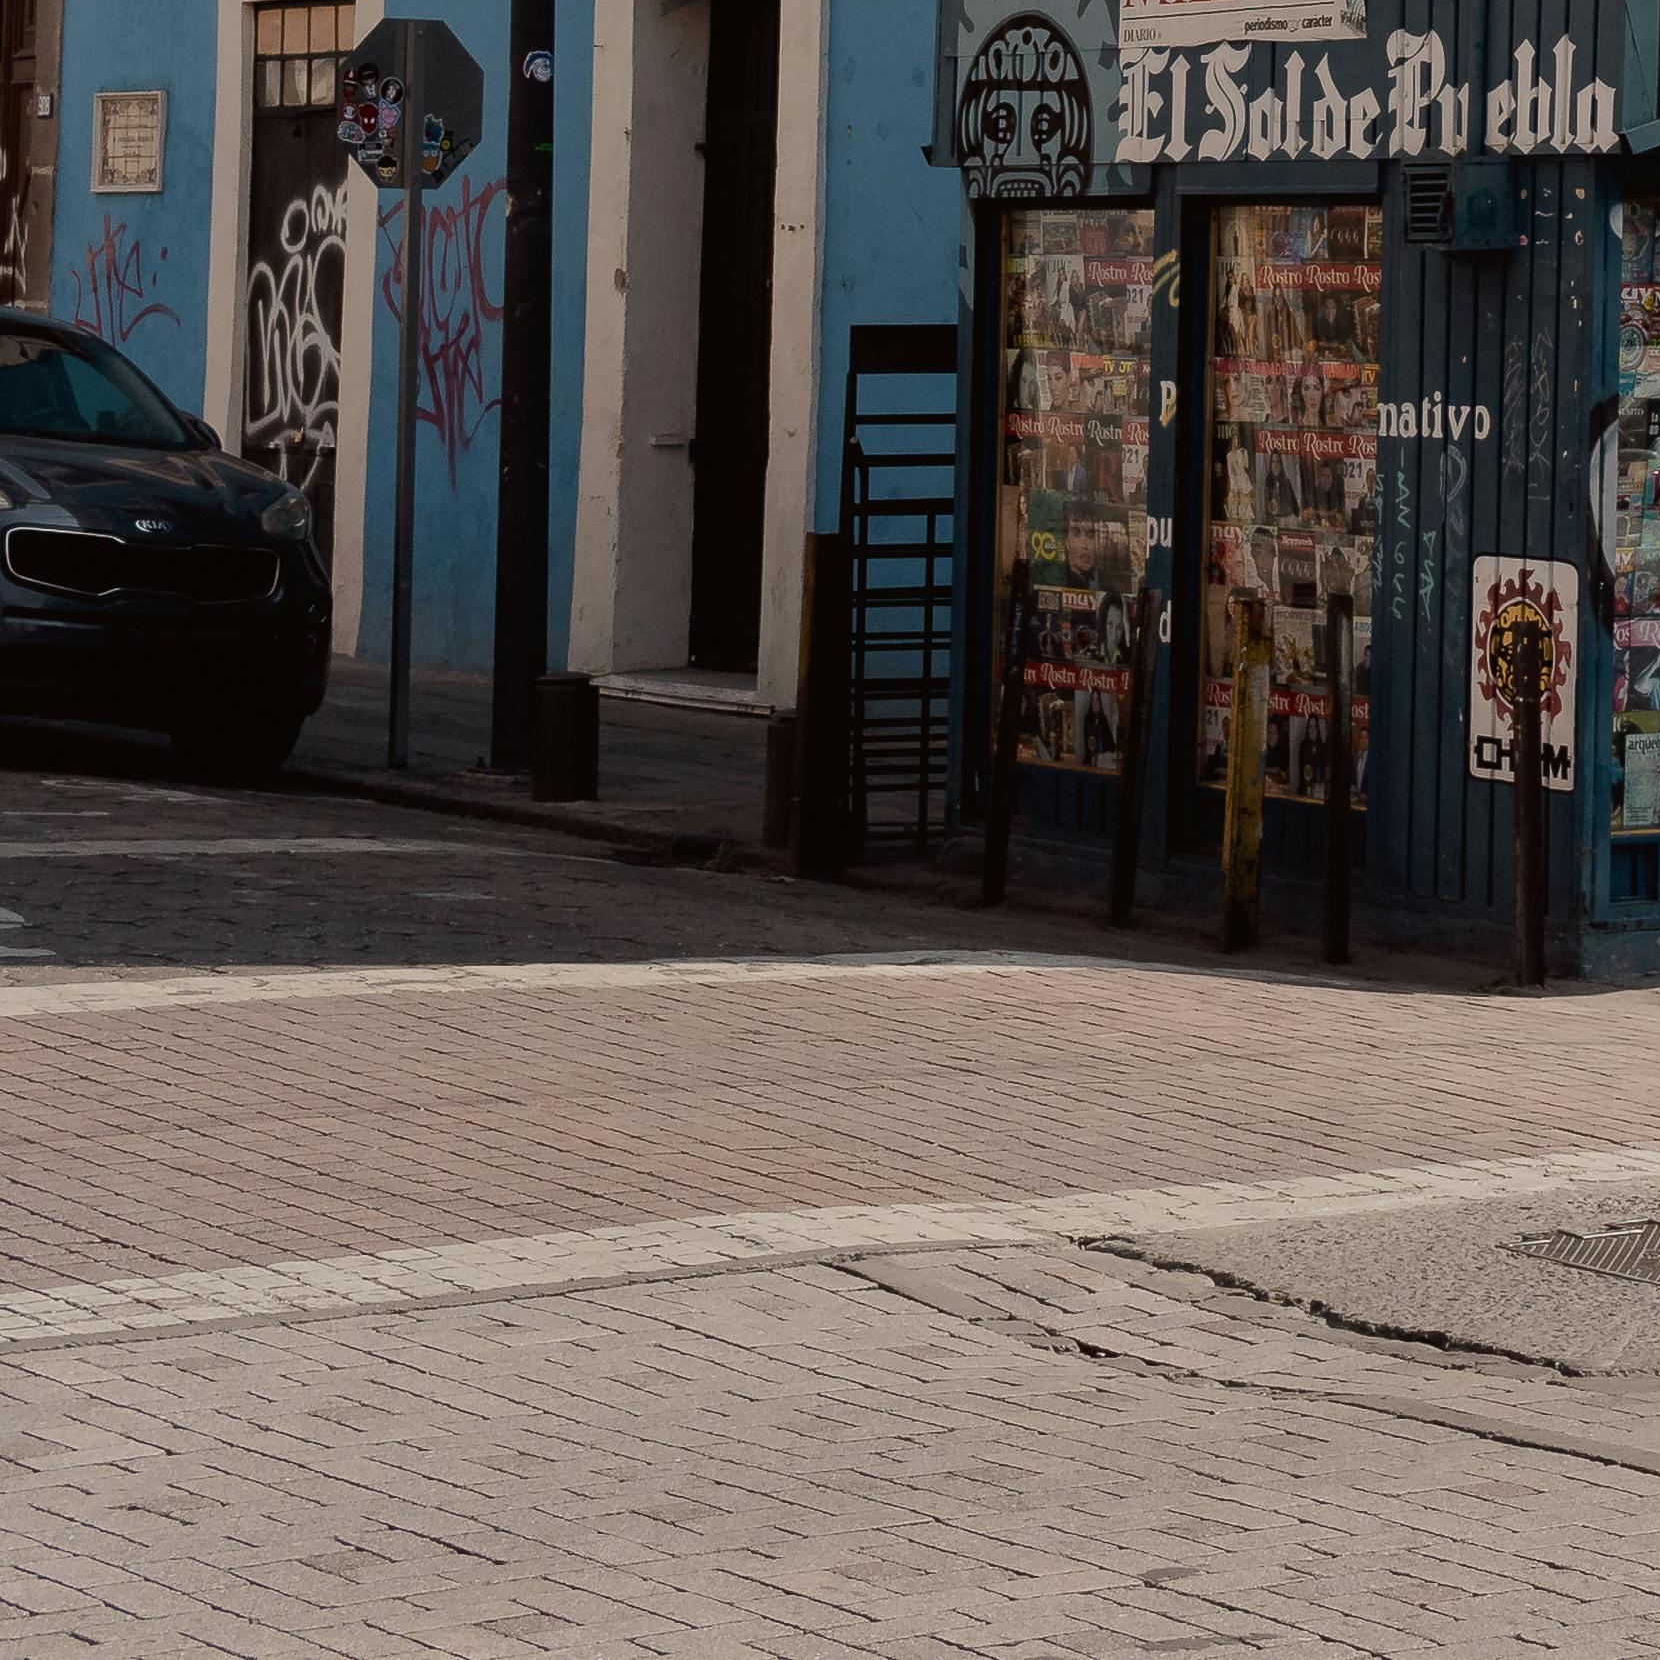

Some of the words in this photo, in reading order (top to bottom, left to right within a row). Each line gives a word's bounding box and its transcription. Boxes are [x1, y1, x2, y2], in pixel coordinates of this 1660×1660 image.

[1123, 28, 1156, 42] DIARIO
[1244, 17, 1287, 35] periodismo
[1116, 46, 1203, 163] El
[1385, 27, 1621, 160] Puebla
[1088, 261, 1128, 287] Rostro
[1261, 265, 1302, 289] Rostro
[1306, 265, 1350, 292] Rostro
